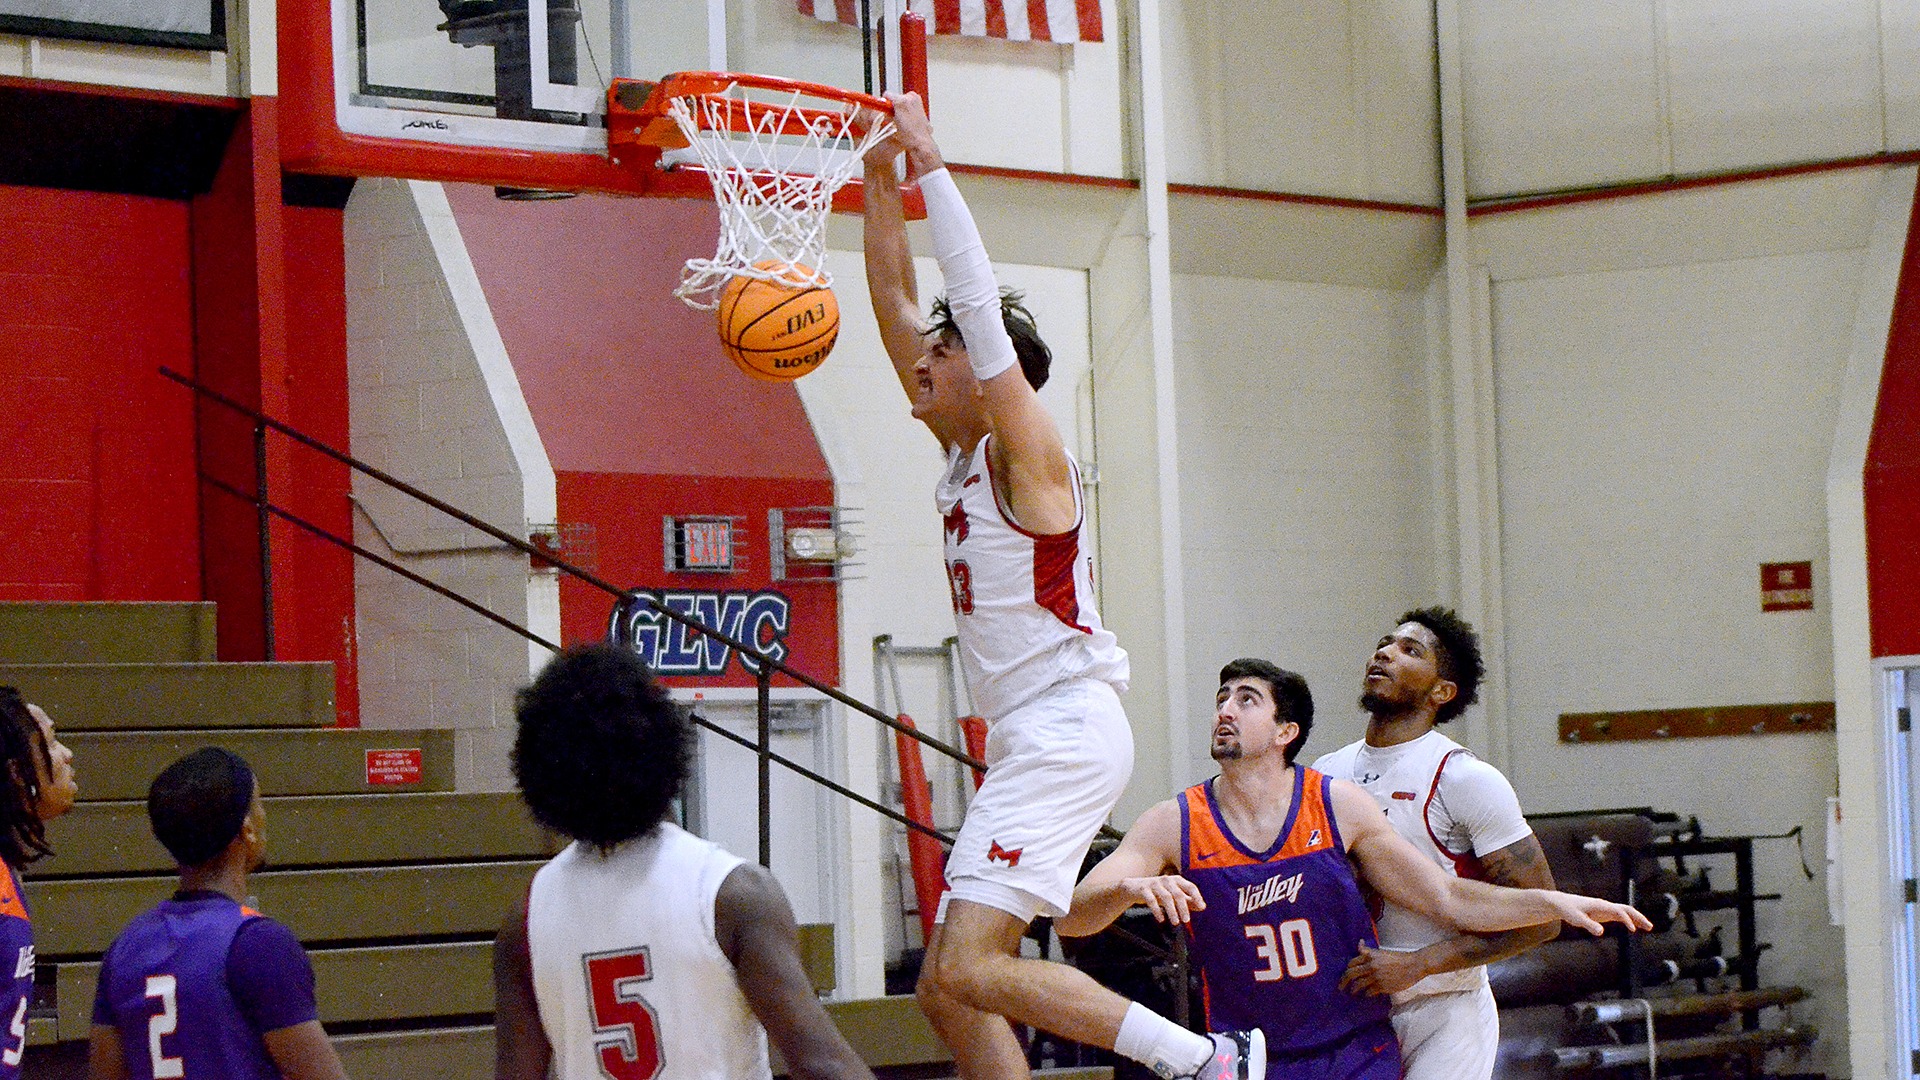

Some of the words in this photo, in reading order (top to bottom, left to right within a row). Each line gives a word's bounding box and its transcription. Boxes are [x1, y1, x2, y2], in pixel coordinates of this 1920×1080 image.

[786, 302, 826, 335] EVO
[687, 524, 729, 564] EXIT
[609, 591, 790, 672] GLVC
[1237, 872, 1304, 915] Valley
[1244, 917, 1319, 982] 30
[144, 973, 186, 1080] 2
[581, 944, 667, 1080] 5
